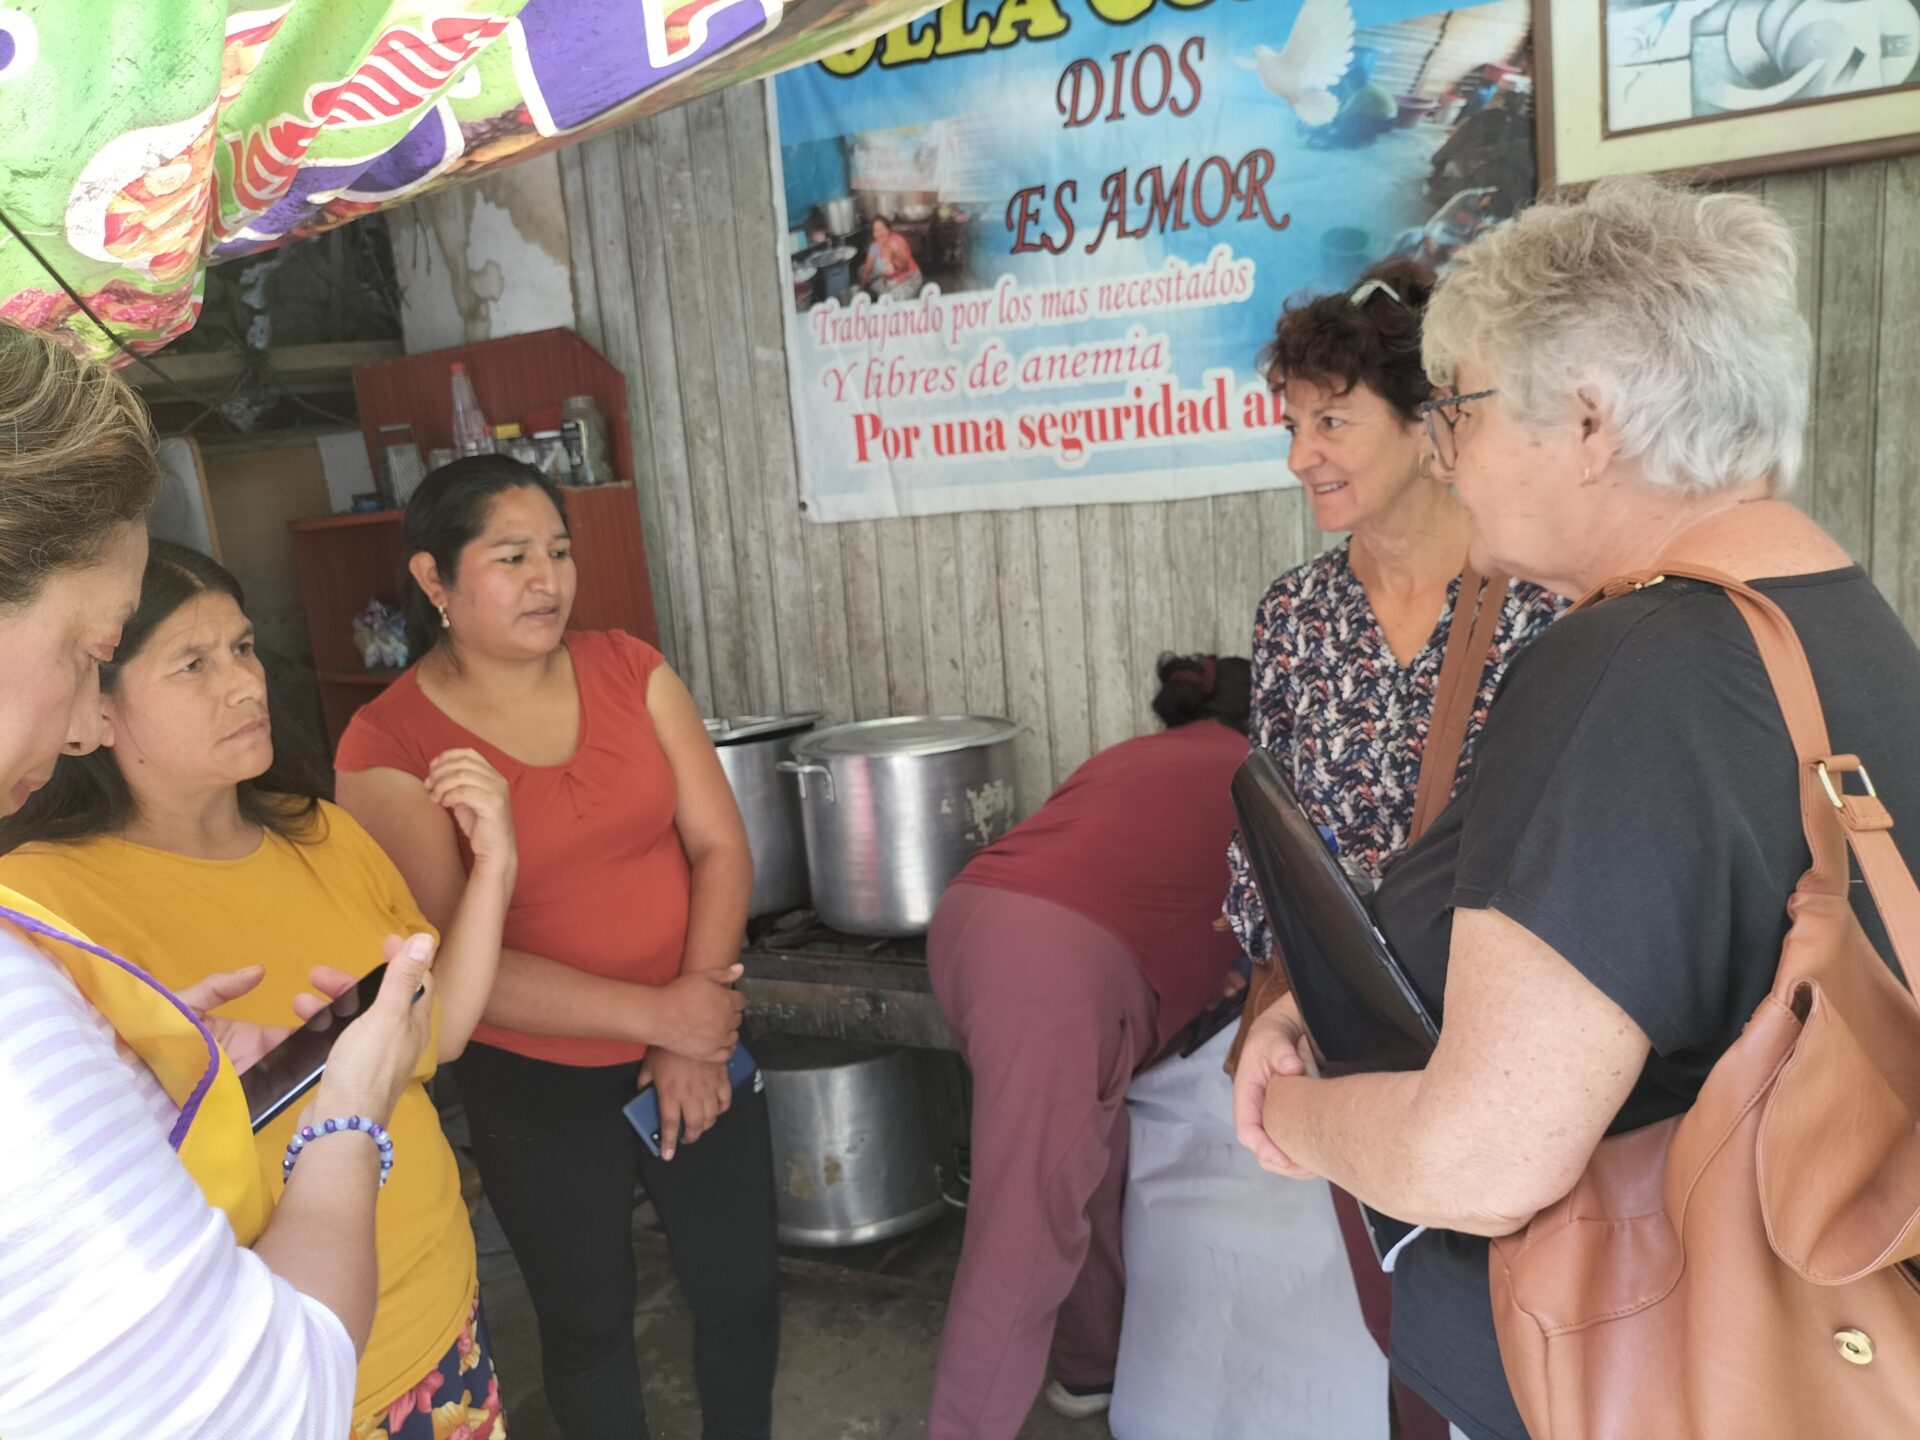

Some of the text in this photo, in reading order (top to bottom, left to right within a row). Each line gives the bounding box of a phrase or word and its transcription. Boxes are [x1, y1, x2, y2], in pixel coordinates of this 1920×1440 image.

[1056, 37, 1205, 129] DIOS
[1006, 148, 1291, 255] ES AMOR
[813, 251, 1249, 352] Trabajando por los mas necesitados
[823, 332, 1164, 403] Y libres de anemia
[854, 412, 921, 463] Por
[932, 417, 1006, 457] una
[1018, 377, 1230, 462] seguridad
